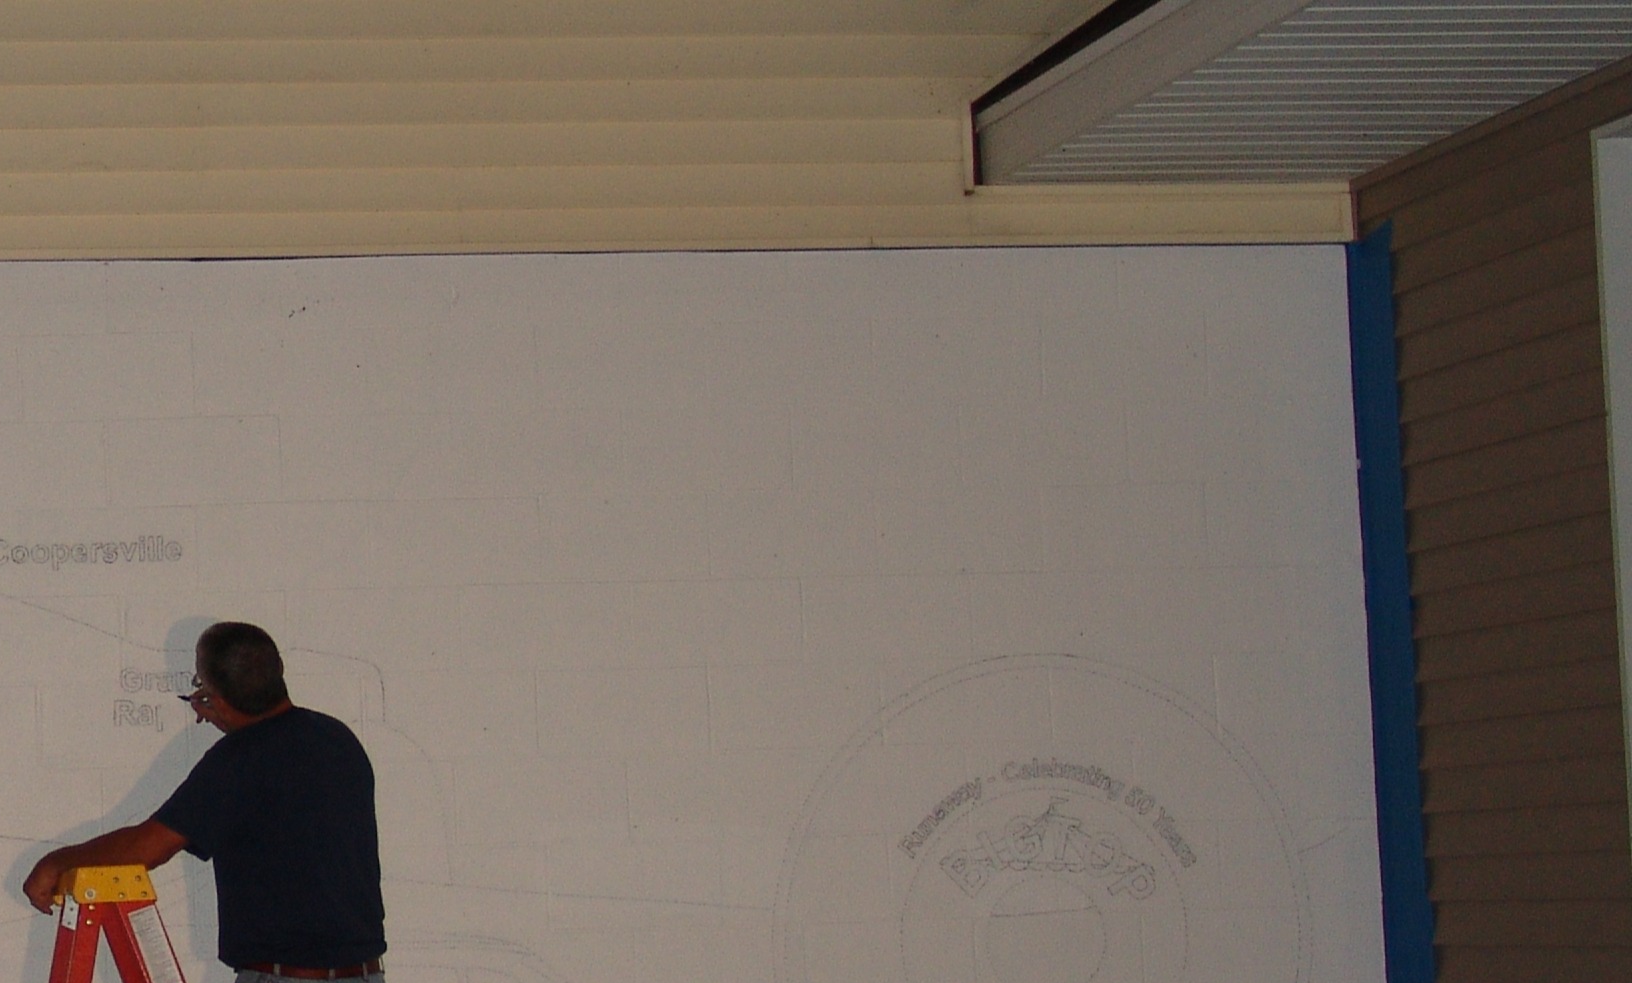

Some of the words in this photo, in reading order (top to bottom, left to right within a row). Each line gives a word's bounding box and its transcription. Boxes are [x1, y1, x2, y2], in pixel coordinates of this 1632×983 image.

[897, 776, 982, 858] Runaway
[1001, 757, 1125, 800] Celebrating
[1153, 806, 1197, 868] Years
